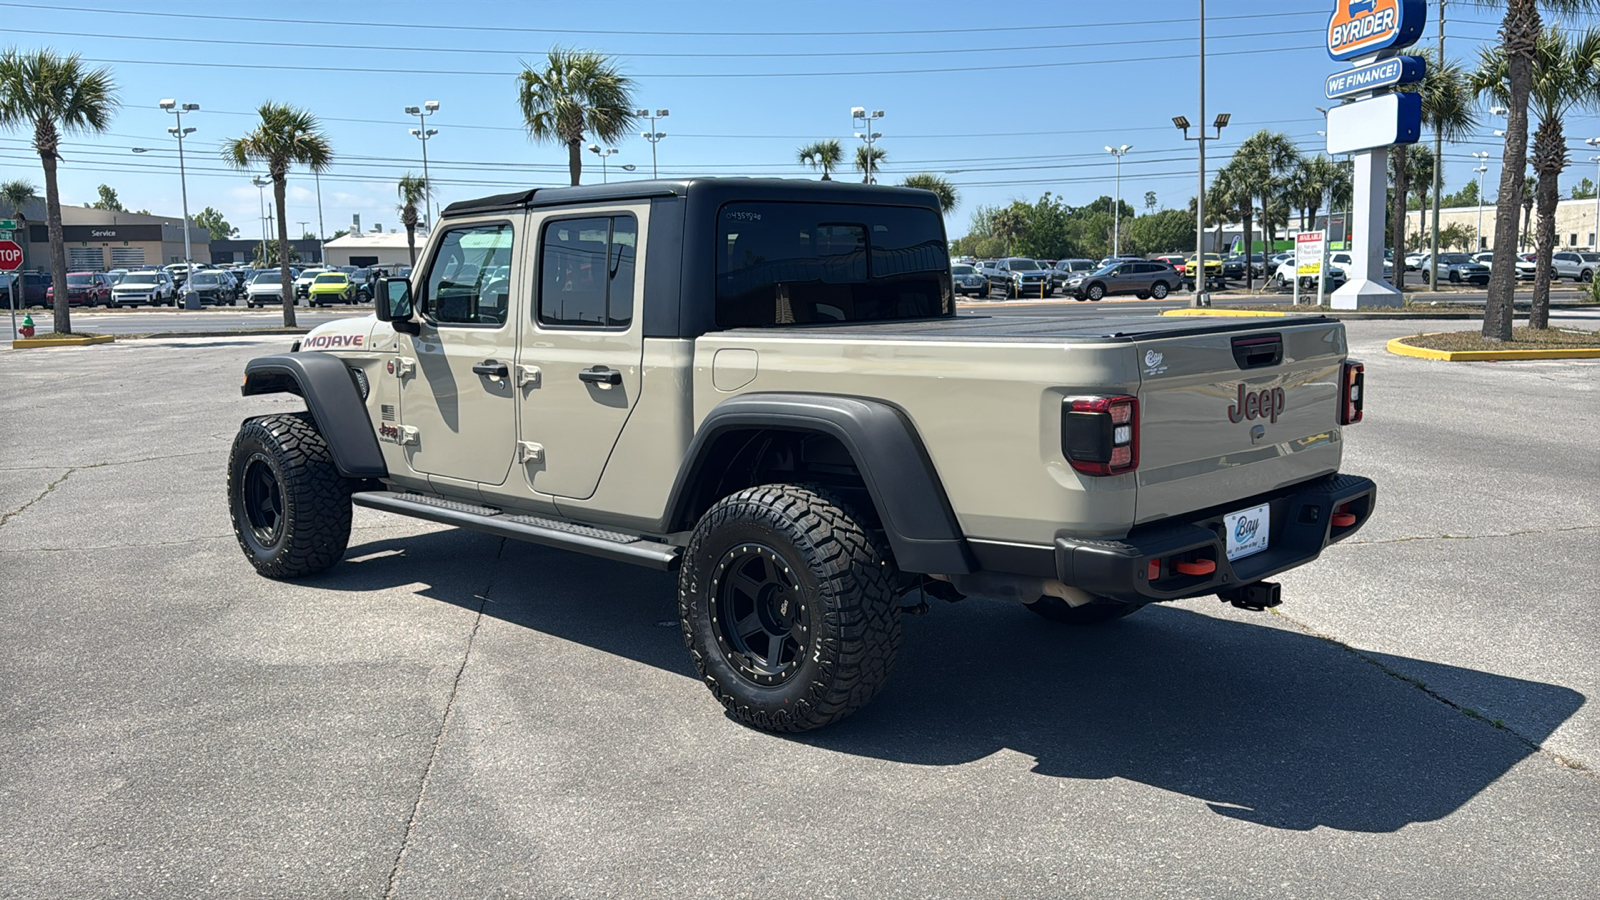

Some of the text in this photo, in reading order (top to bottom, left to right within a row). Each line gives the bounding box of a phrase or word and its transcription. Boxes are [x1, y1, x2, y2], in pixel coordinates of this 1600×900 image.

[1331, 7, 1394, 47] BYRIDER
[1329, 63, 1397, 93] WE FINANCE!
[91, 229, 117, 237] Service
[0, 249, 20, 261] TOP
[303, 335, 364, 348] MOJAVE
[1227, 383, 1286, 424] Jeep
[1236, 516, 1260, 539] Bay
